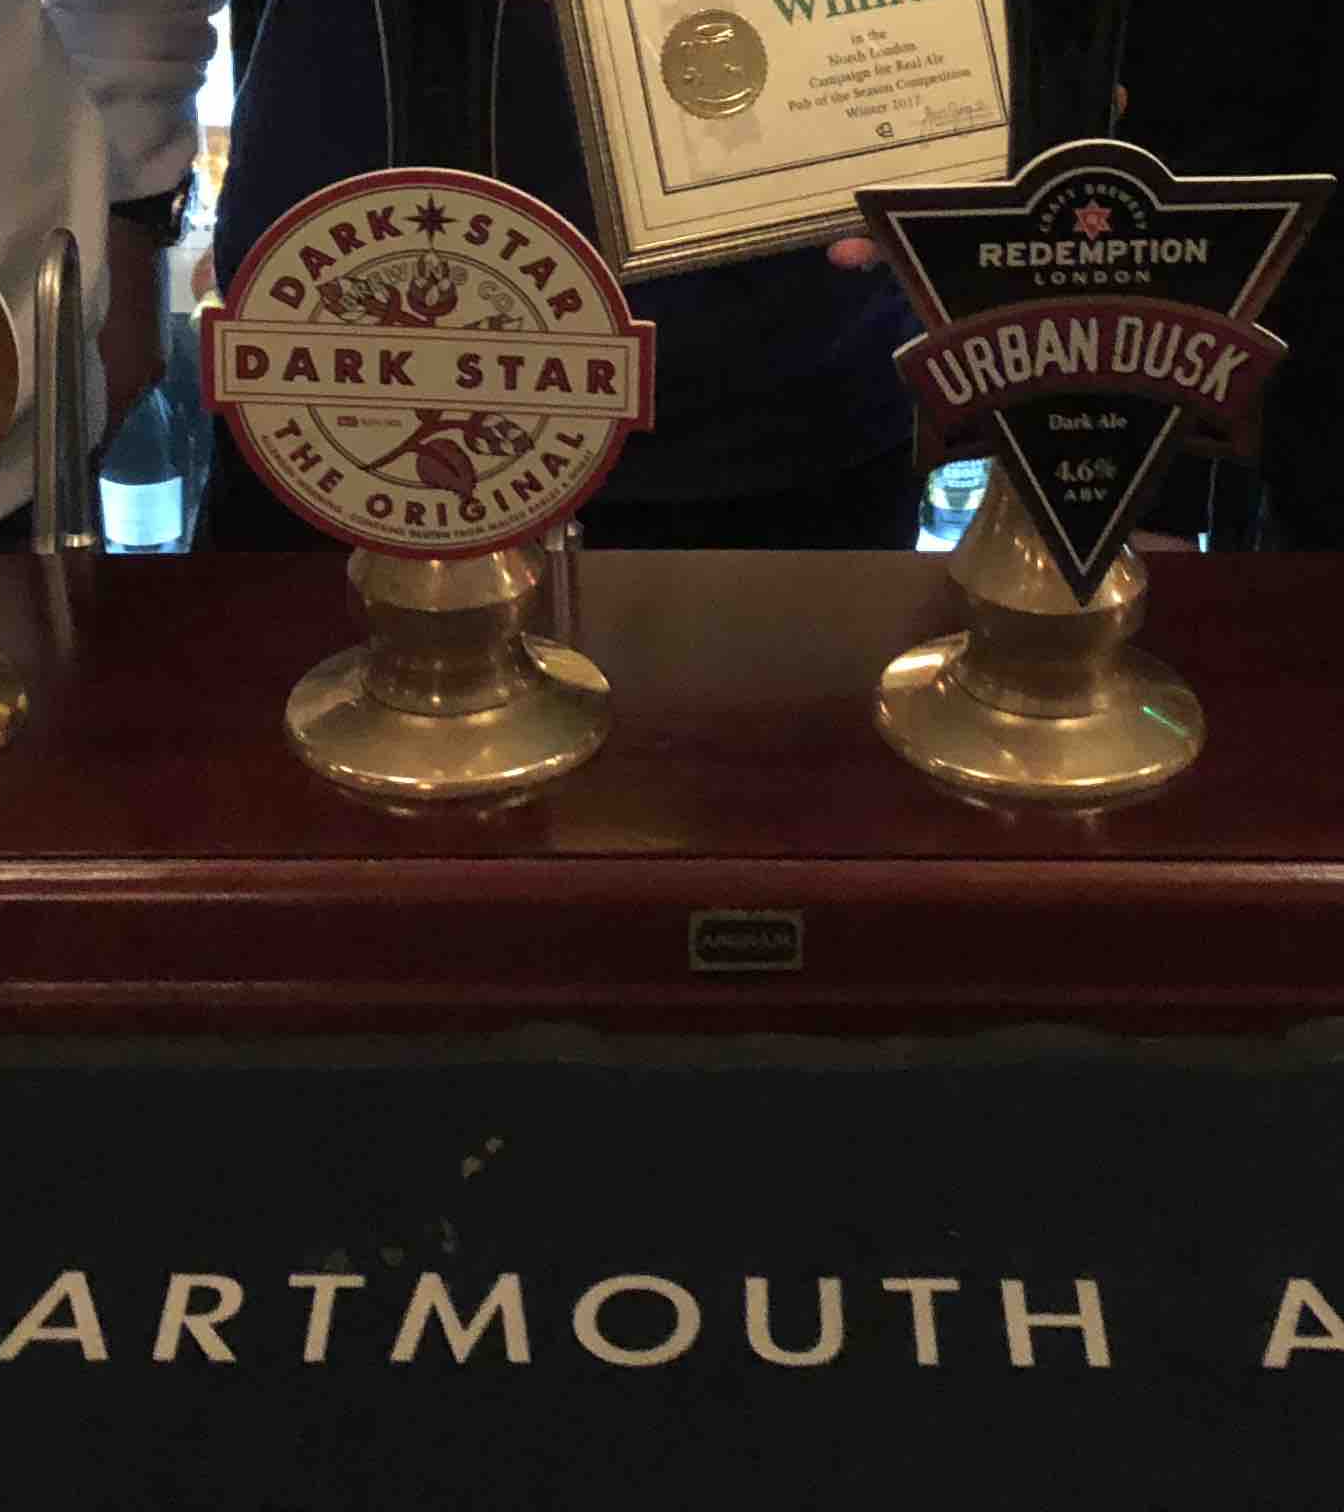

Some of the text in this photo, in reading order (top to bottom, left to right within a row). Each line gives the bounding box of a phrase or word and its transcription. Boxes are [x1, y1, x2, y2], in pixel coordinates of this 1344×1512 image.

[826, 41, 918, 67] North London
[808, 68, 872, 90] Campaign
[895, 55, 922, 72] Real
[787, 99, 812, 112] Pub
[830, 90, 850, 104] the
[852, 82, 894, 99] Season
[268, 204, 583, 322] DARK STAR
[978, 237, 1209, 269] REDEMPTION
[1033, 269, 1152, 286] LONDON
[234, 343, 618, 397] DARK STAR
[926, 316, 1251, 406] URBAN DUSK
[1048, 412, 1129, 431] Dark Ale
[272, 417, 346, 496] THE
[364, 428, 587, 528] ORIGINAL
[1062, 487, 1108, 504] ABV
